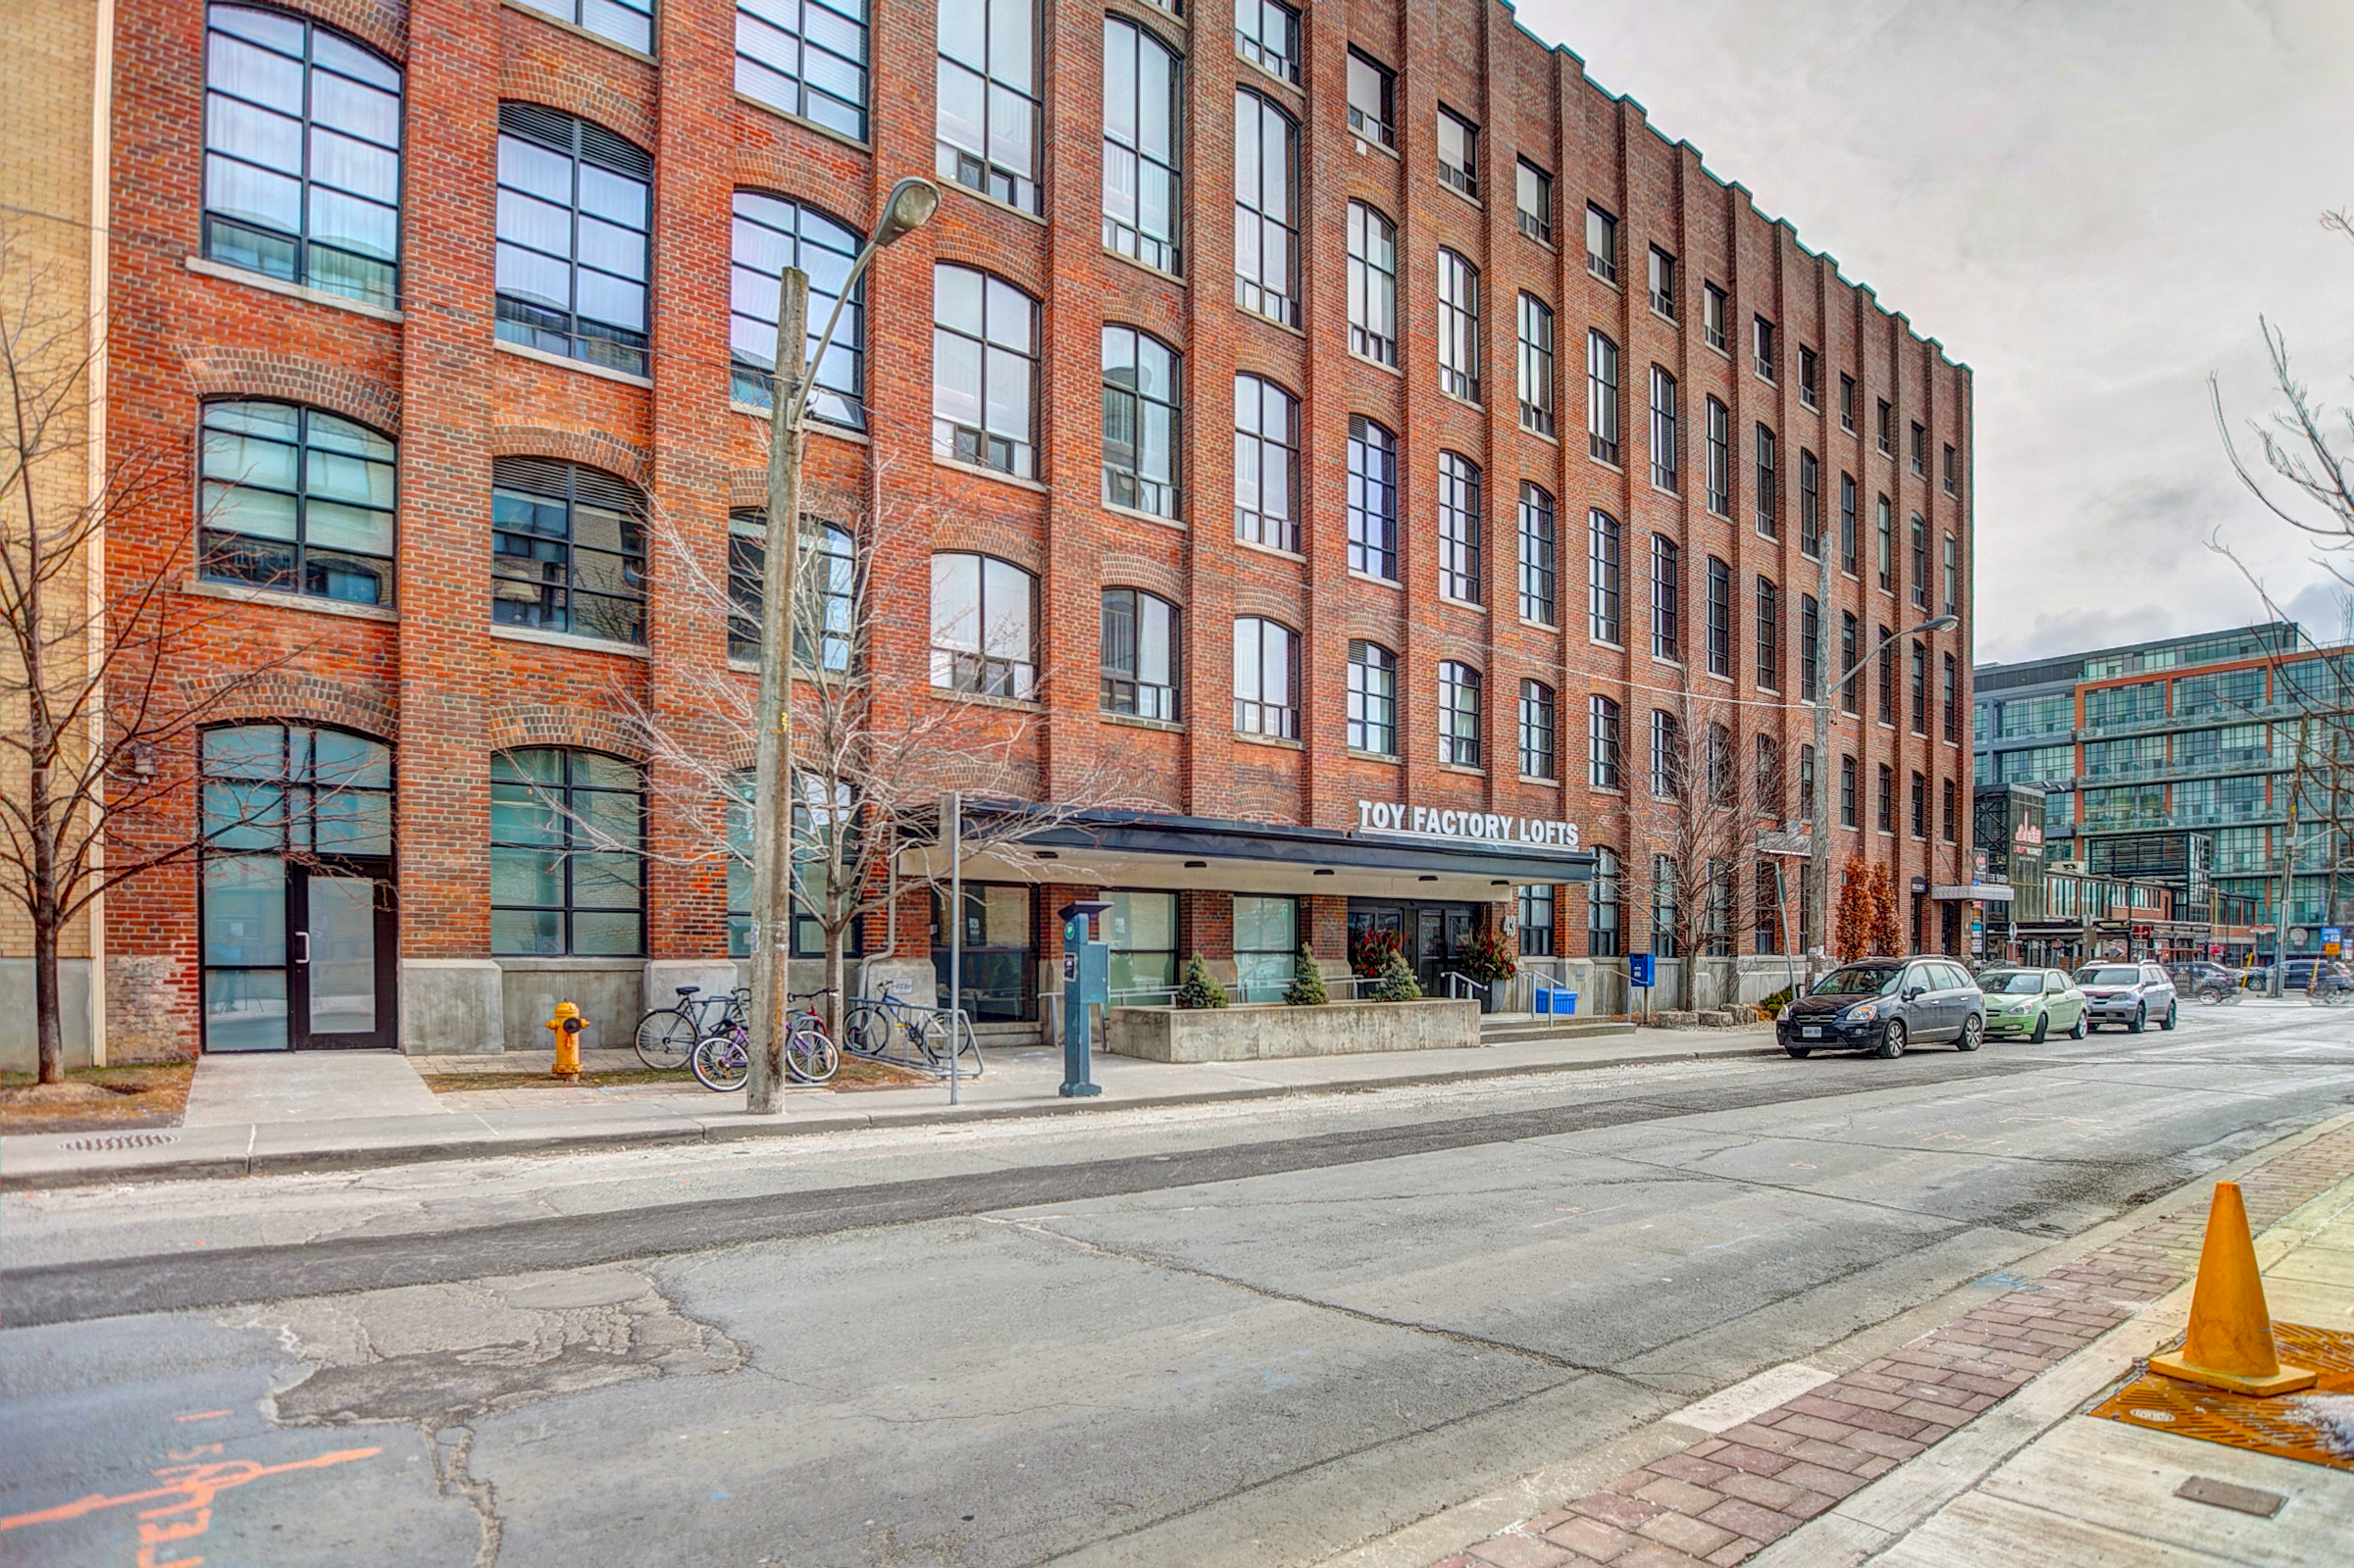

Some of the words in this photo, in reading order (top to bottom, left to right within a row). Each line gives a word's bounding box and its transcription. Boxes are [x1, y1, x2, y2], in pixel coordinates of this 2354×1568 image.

[1357, 799, 1407, 829] TOY
[1412, 806, 1513, 839] FACTORY
[1519, 818, 1579, 846] LOFTS
[1503, 915, 1516, 937] 43
